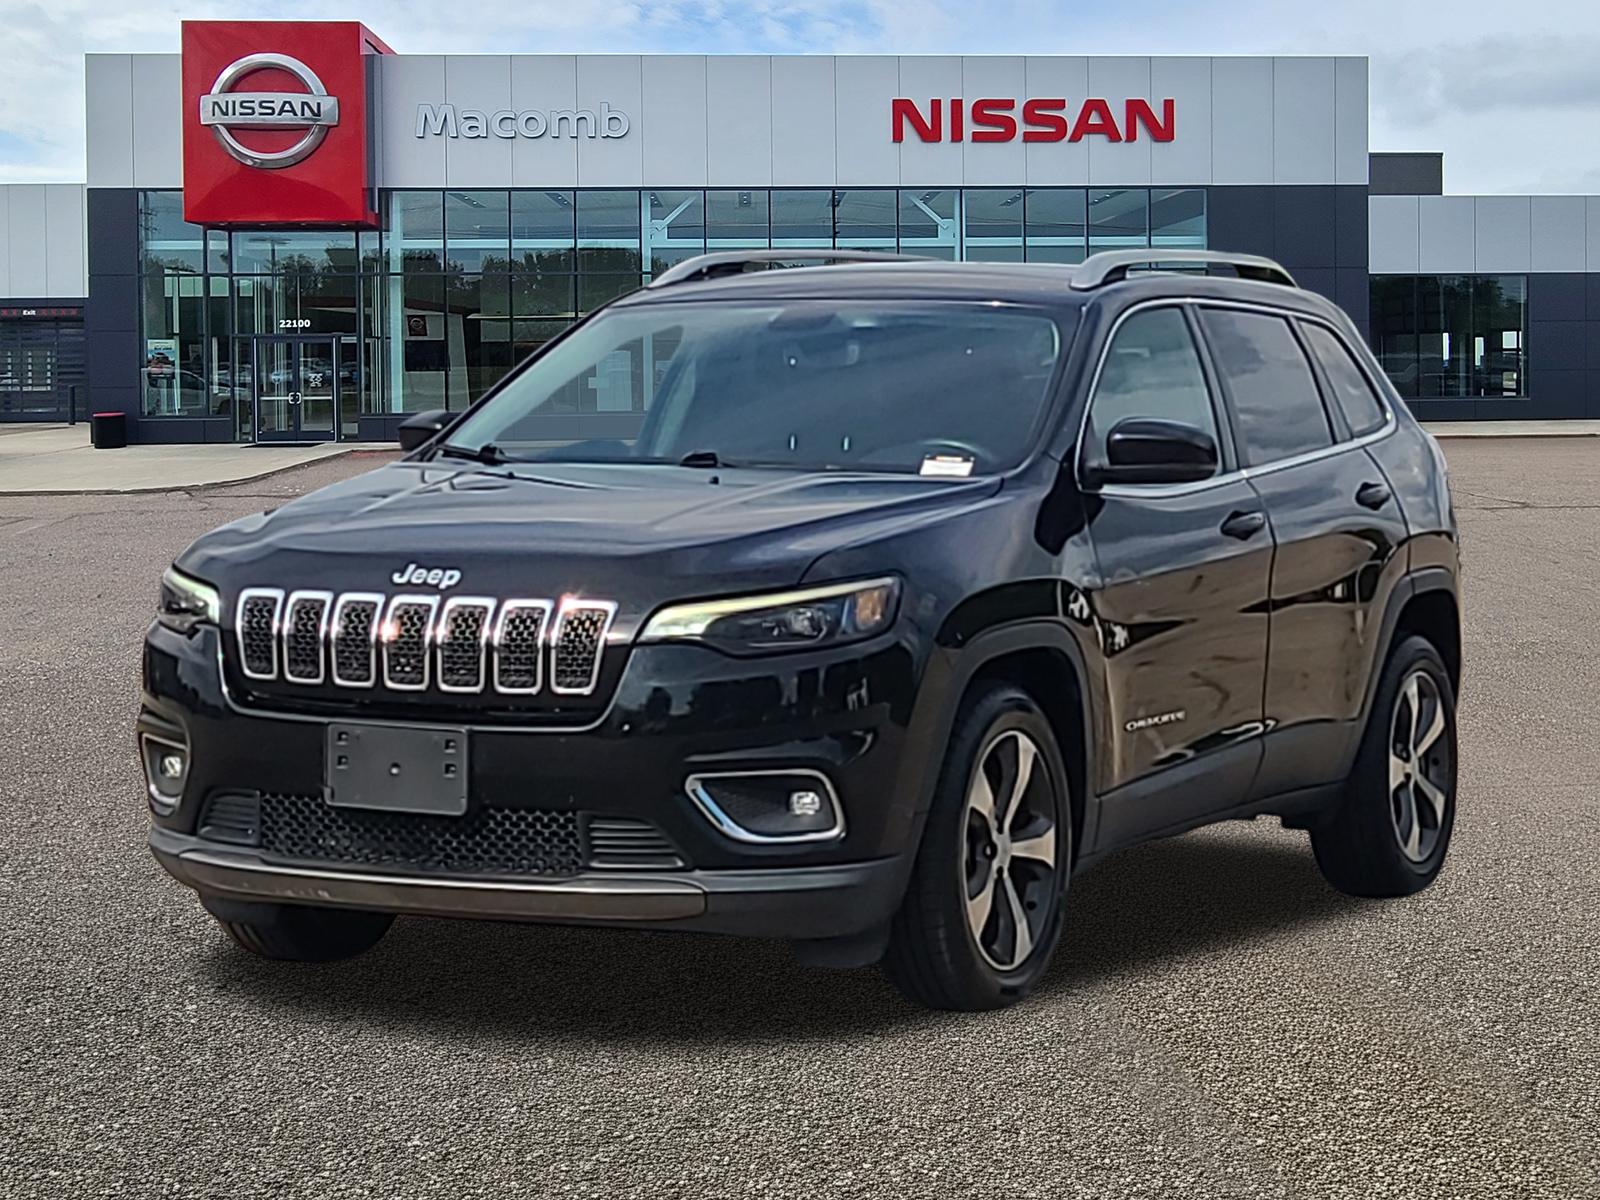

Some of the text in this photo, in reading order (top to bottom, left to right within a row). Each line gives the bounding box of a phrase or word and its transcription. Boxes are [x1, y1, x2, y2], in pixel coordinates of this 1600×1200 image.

[211, 99, 322, 118] NISSAN
[415, 102, 630, 140] Macomb
[892, 98, 1175, 143] NISSAN
[279, 319, 311, 328] 22100
[392, 563, 462, 589] Jeep
